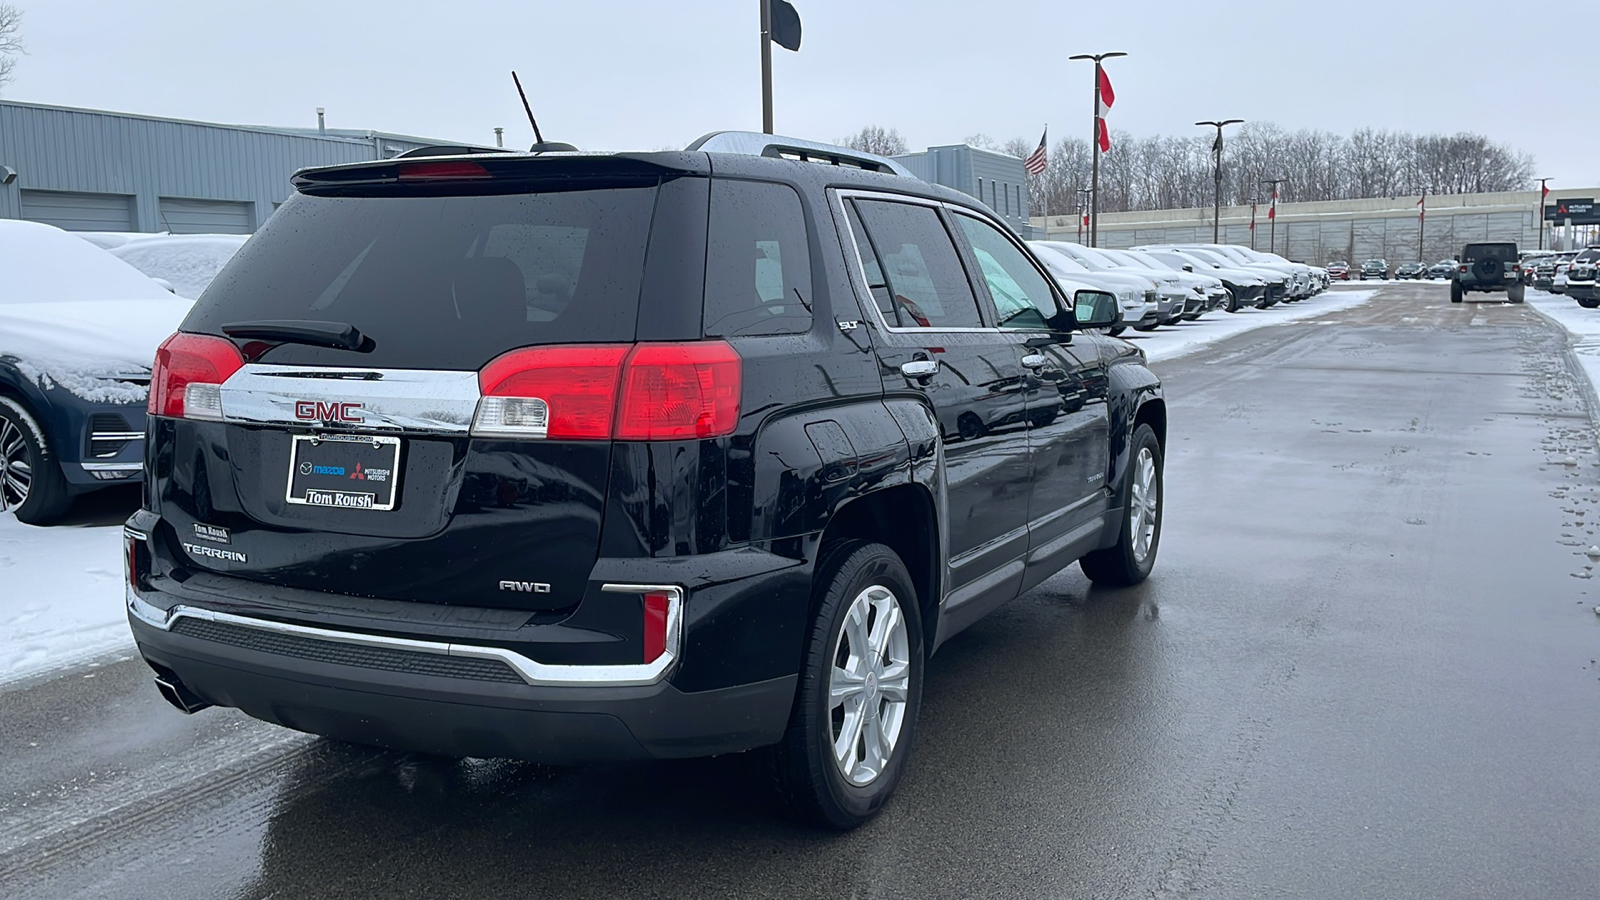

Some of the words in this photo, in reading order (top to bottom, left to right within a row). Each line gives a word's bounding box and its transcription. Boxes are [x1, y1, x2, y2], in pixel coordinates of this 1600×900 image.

[839, 321, 858, 330] SLT
[295, 400, 362, 422] GMC
[364, 468, 390, 476] MITSUBISHI
[308, 491, 333, 505] Tom
[334, 493, 372, 508] Roush
[193, 523, 208, 534] Tom
[208, 526, 228, 538] Roush
[183, 542, 246, 562] TERRAIN
[499, 580, 551, 593] AWD
